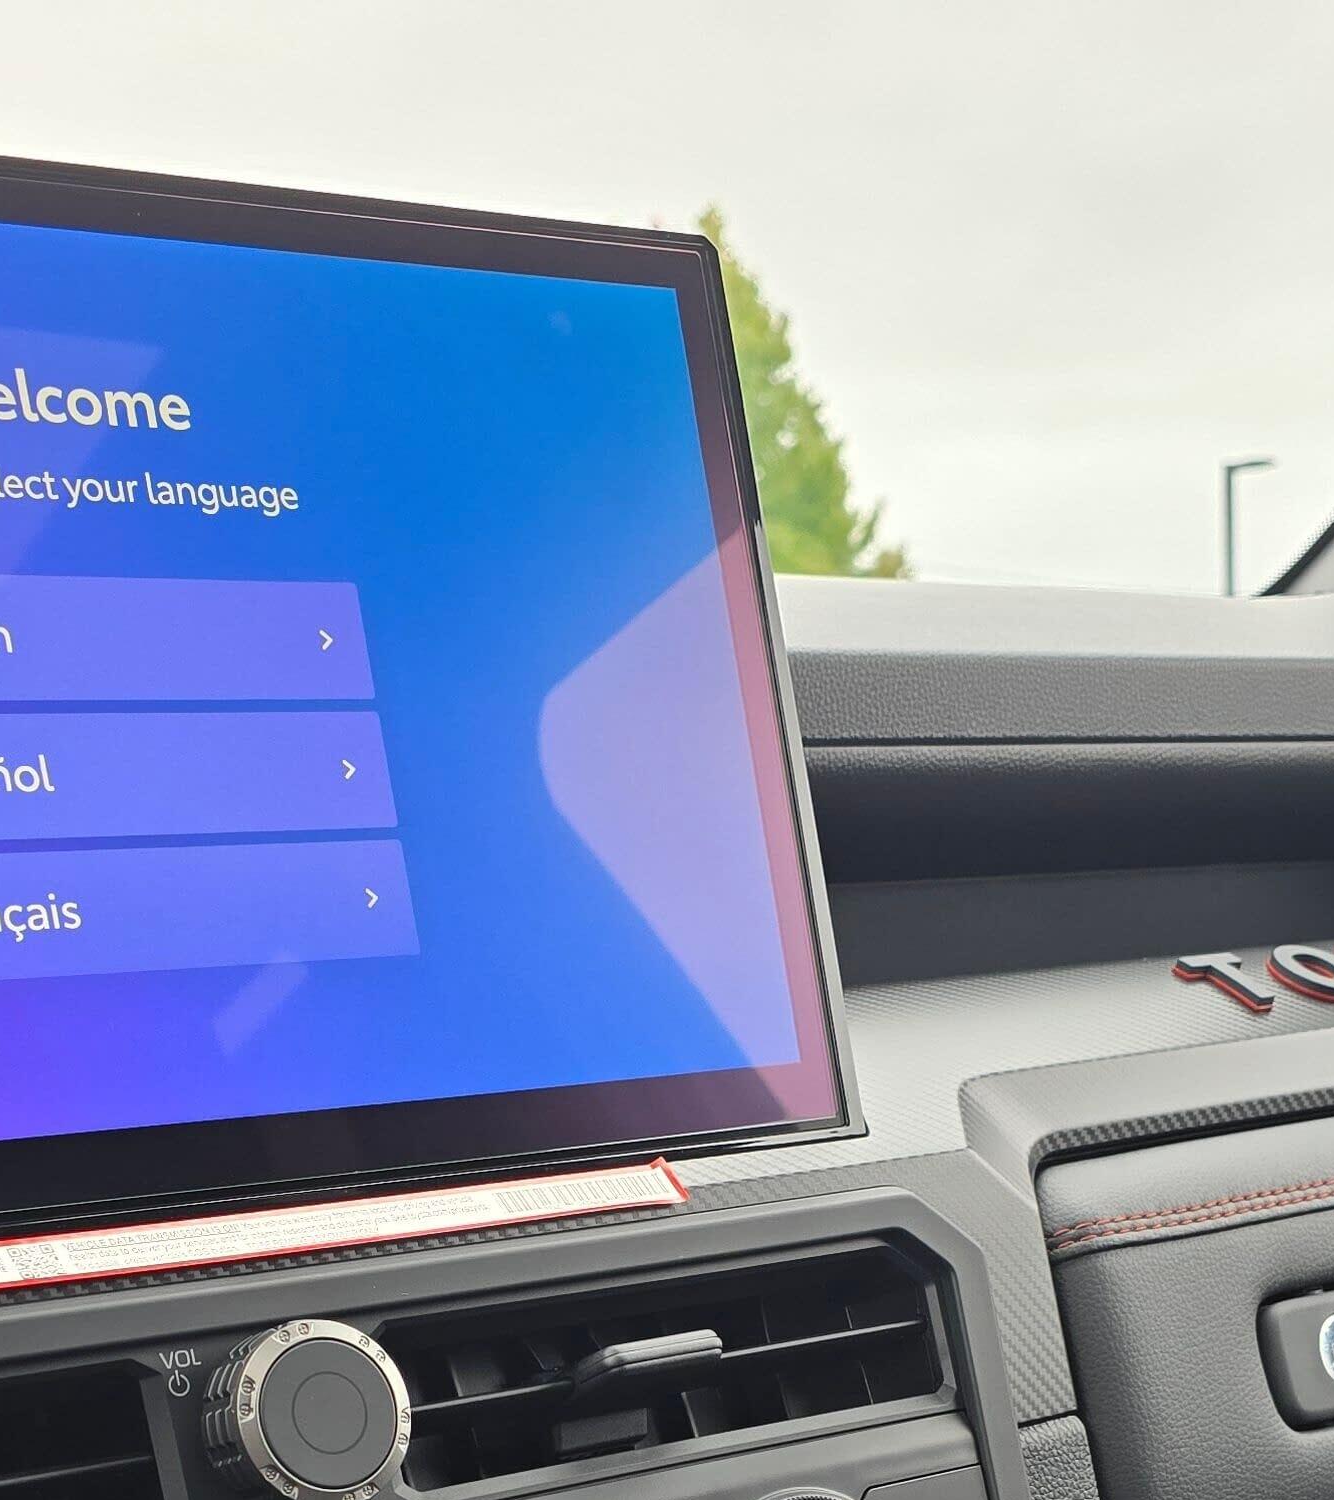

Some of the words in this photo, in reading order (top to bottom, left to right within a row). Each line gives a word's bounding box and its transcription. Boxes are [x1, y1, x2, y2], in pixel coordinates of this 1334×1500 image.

[62, 477, 138, 509] your
[145, 471, 299, 517] language
[107, 1235, 134, 1247] DATA
[158, 1348, 202, 1370] VOL
